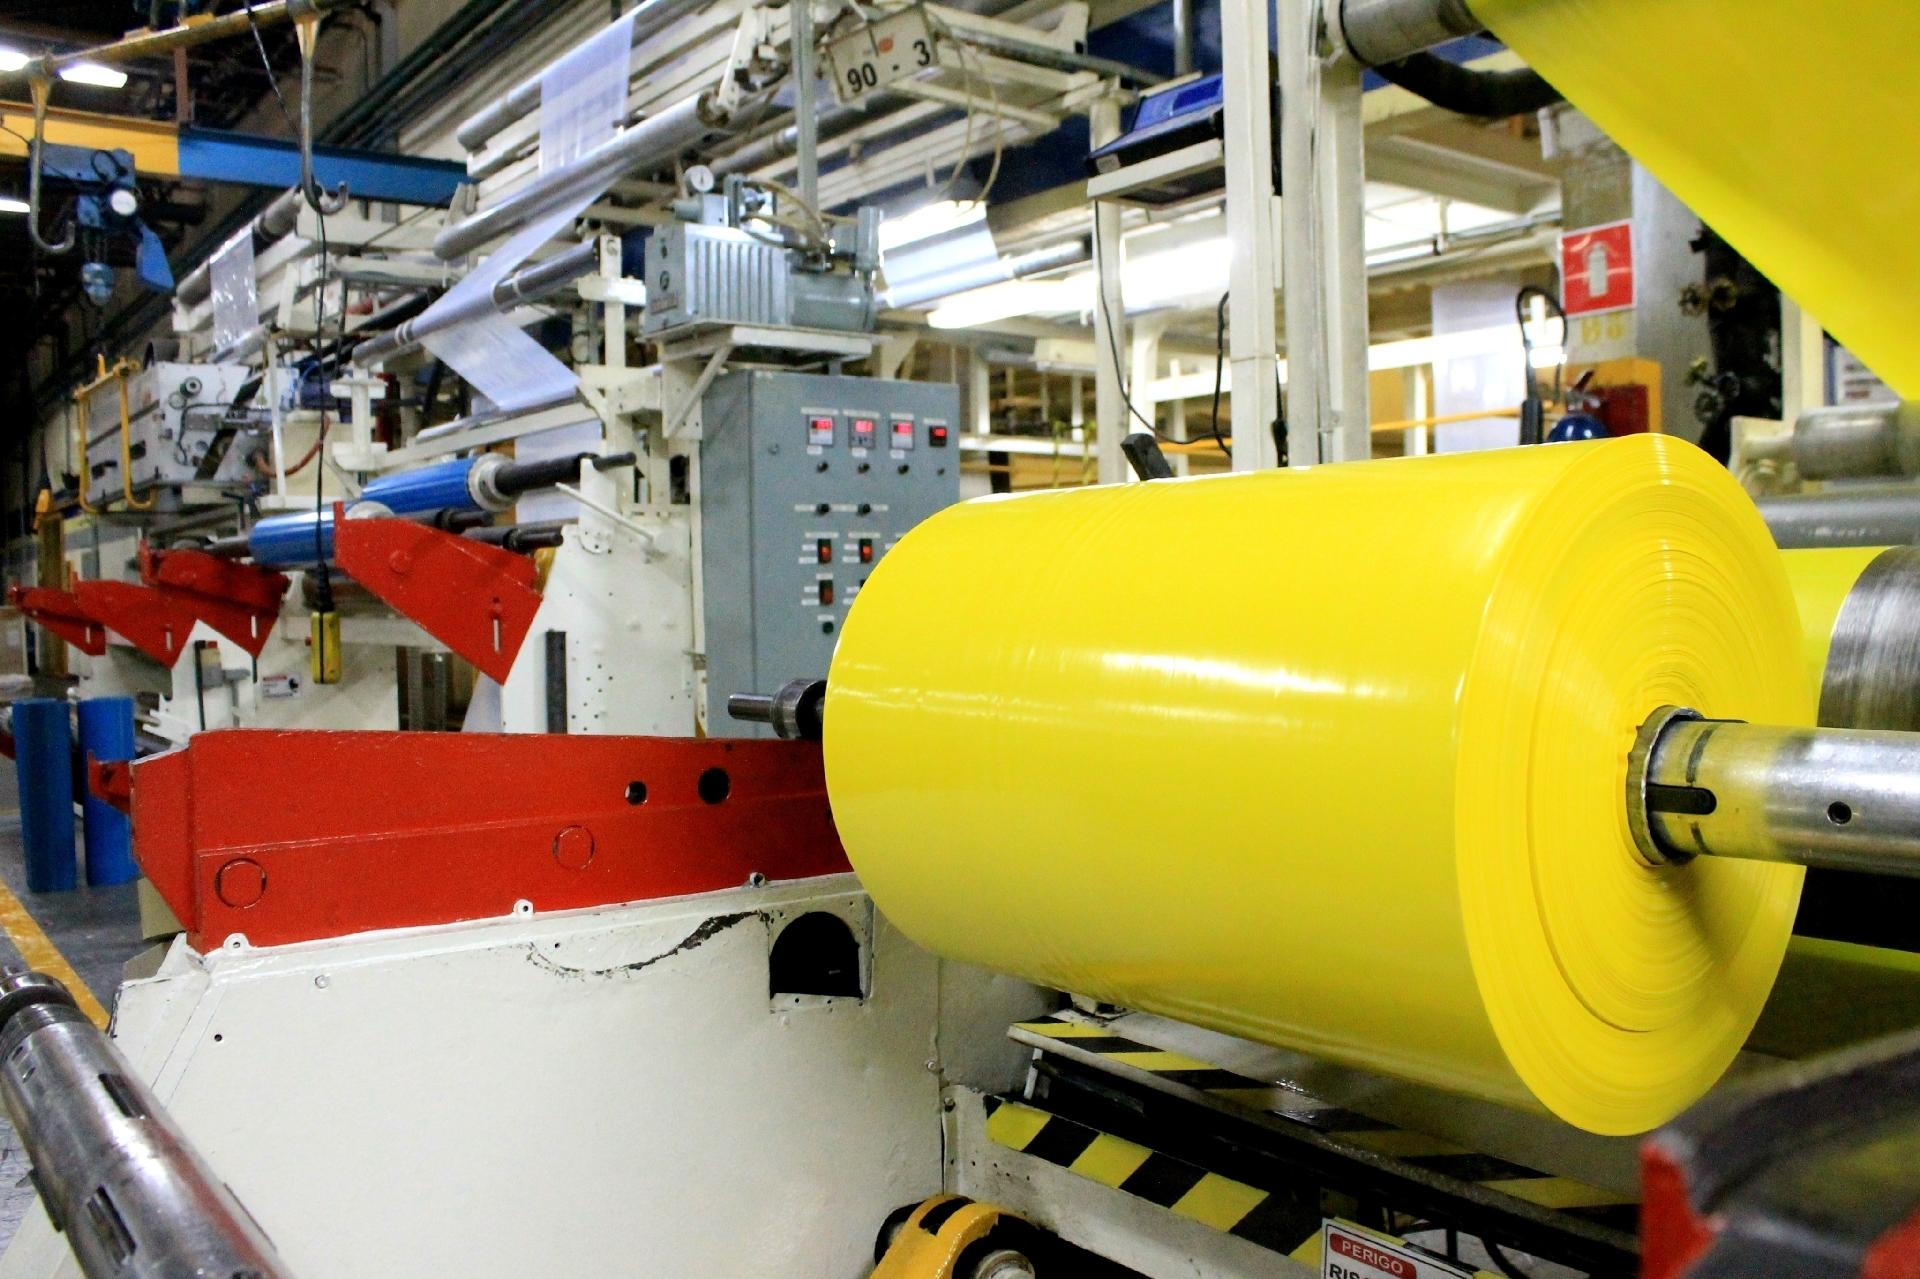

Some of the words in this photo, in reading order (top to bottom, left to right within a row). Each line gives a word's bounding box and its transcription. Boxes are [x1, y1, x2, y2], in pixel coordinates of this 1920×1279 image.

[847, 61, 877, 92] 90
[914, 38, 930, 66] 3
[1342, 1240, 1403, 1273] PERIGO
